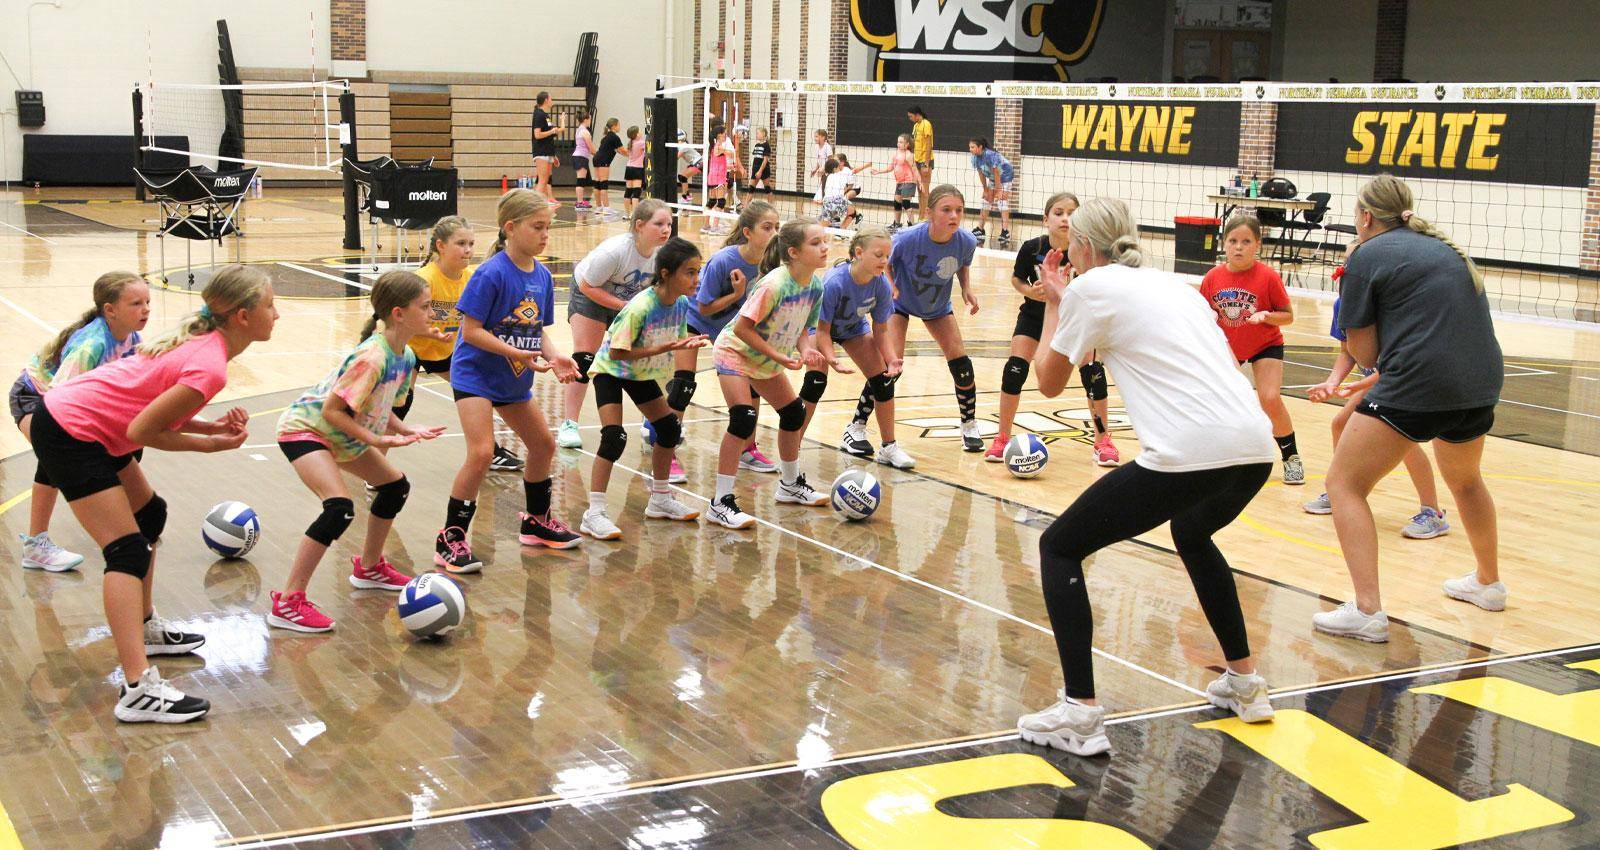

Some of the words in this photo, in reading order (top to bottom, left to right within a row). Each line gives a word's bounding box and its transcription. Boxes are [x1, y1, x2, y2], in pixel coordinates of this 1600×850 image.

[896, 0, 1045, 53] WSC
[1462, 87, 1518, 100] NORTHEAST
[1520, 87, 1572, 100] NEBRASKA
[1061, 104, 1196, 155] WAYNE
[1344, 108, 1507, 171] STATE
[213, 175, 241, 188] molten
[408, 189, 446, 201] molten
[1015, 454, 1041, 464] molten
[848, 484, 873, 506] molten
